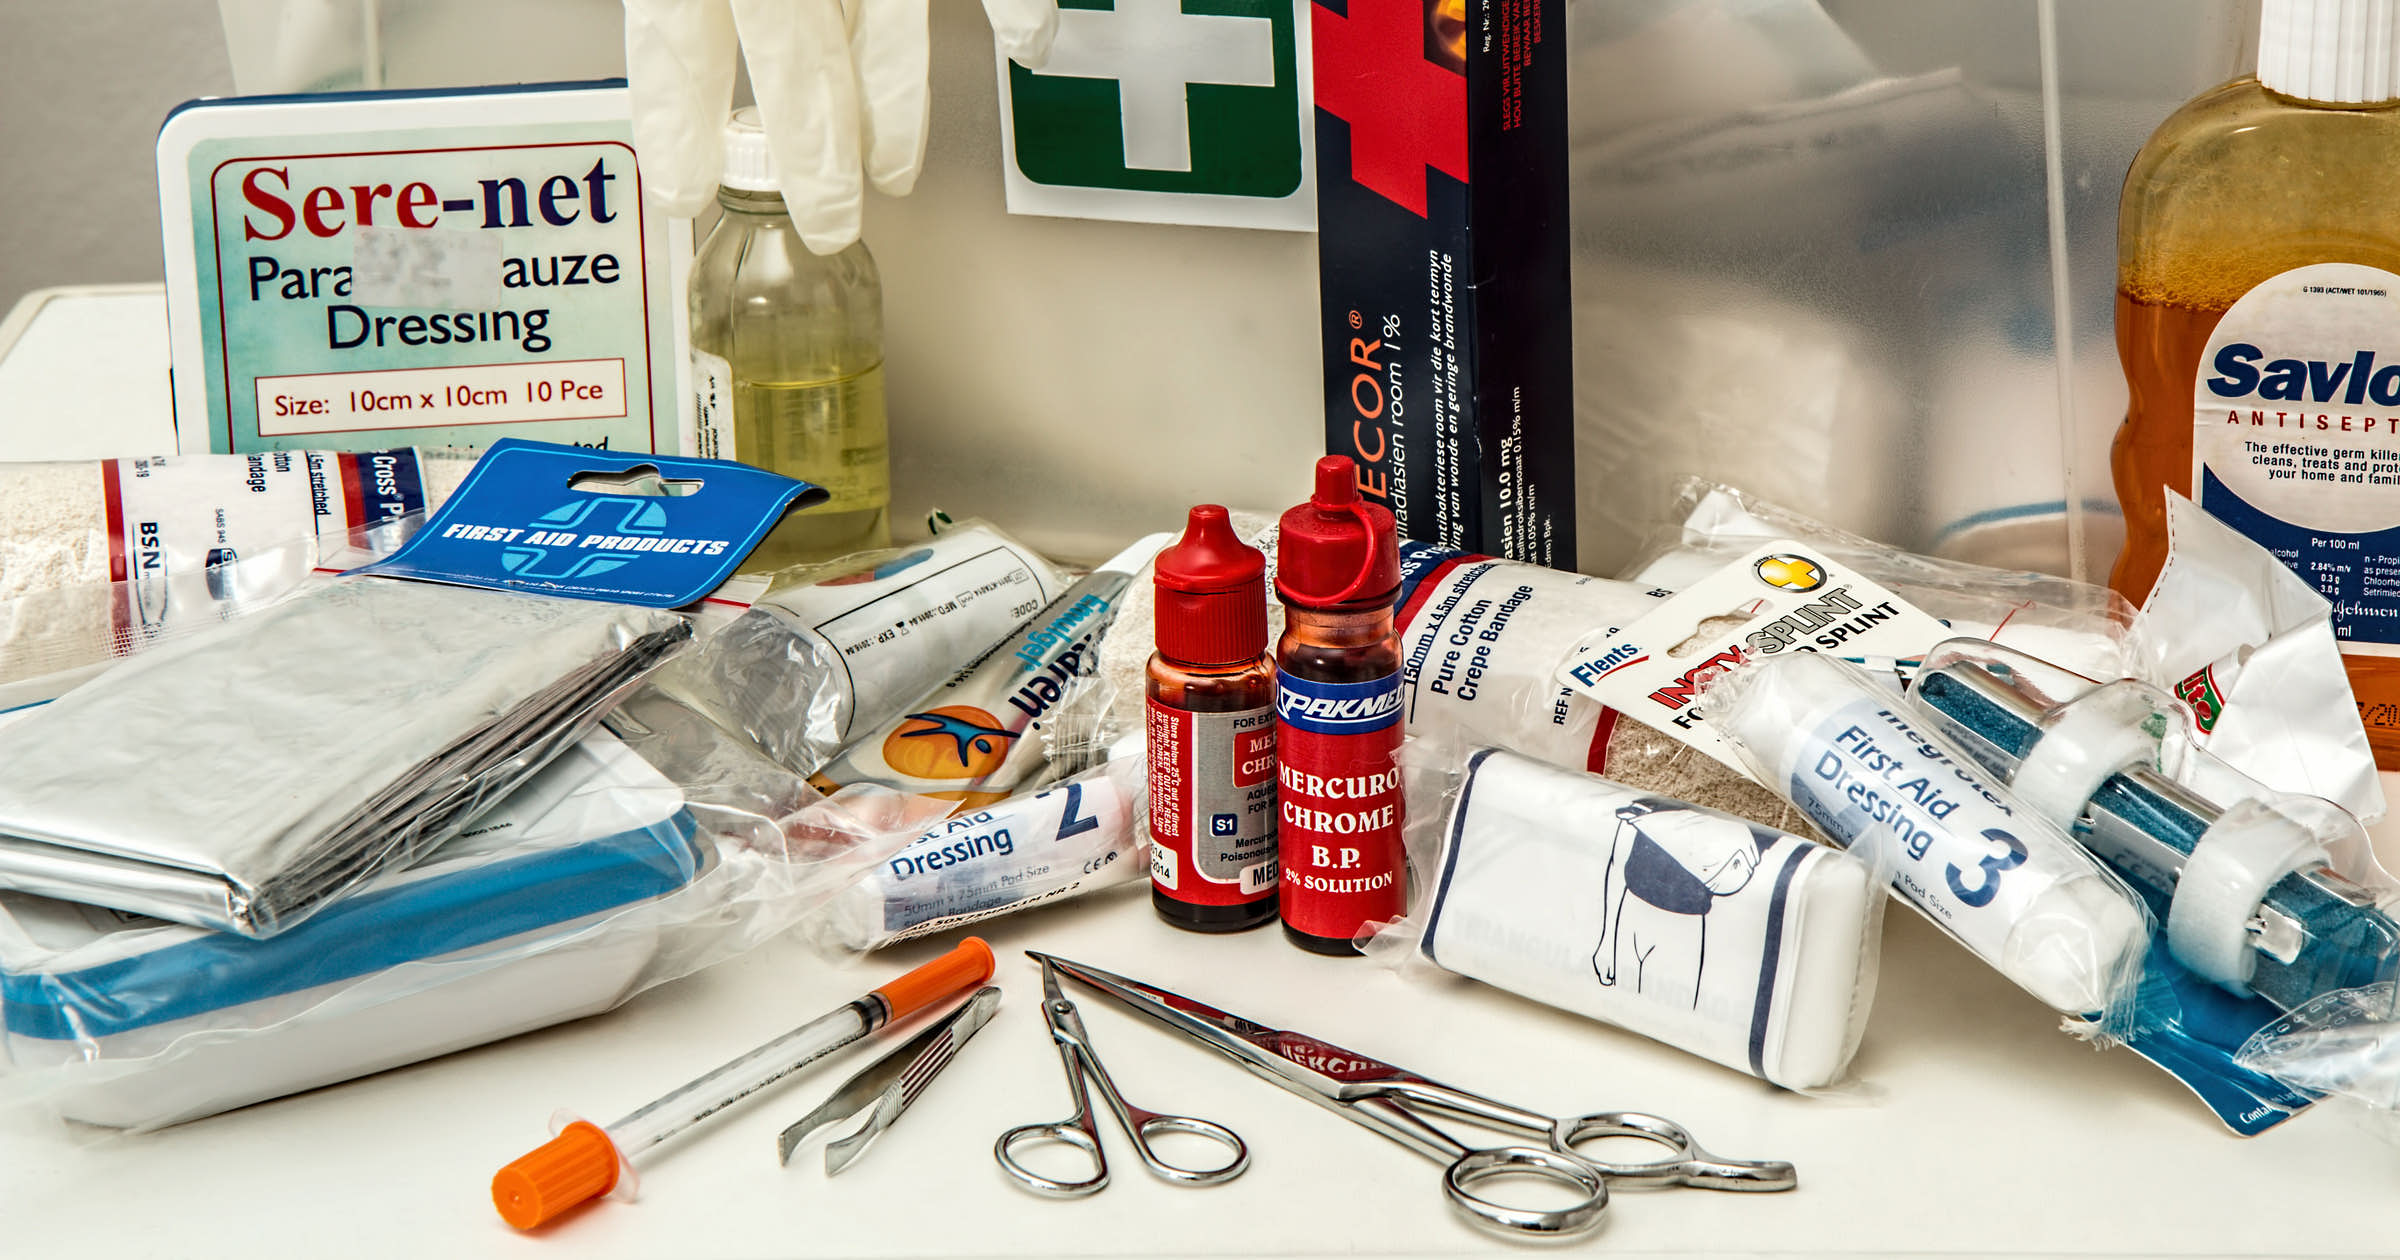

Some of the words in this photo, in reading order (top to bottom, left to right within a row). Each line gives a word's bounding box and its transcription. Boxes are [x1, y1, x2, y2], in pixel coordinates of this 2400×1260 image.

[1513, 100, 1521, 128] HOU
[241, 156, 618, 243] Sere-net
[249, 255, 352, 301] Para
[502, 251, 621, 289] auze
[1429, 250, 1441, 305] termyn
[1443, 254, 1455, 350] brandwonde
[327, 304, 553, 353] Dressing
[1430, 309, 1441, 342] kort
[1431, 347, 1442, 371] die
[1432, 373, 1443, 394] vir
[1445, 354, 1460, 412] geringe
[2207, 343, 2400, 406] Savlo
[275, 394, 330, 417] Size:
[349, 388, 412, 413] 10cm
[421, 393, 435, 408] x
[444, 385, 508, 408] 10cm
[526, 380, 553, 403] 10
[560, 379, 604, 402] Pce
[1389, 363, 1404, 427] room
[1447, 415, 1458, 434] en
[1513, 415, 1523, 452] 0.15%
[2227, 410, 2400, 434] ANTISEPT
[273, 451, 292, 473] otton
[1447, 438, 1460, 488] wonde
[1500, 437, 1513, 467] mg
[2245, 441, 2268, 452] The
[2272, 443, 2328, 456] effective
[2333, 448, 2365, 460] germ
[2252, 454, 2297, 468] cleans,
[2302, 458, 2339, 470] treats
[2344, 460, 2367, 472] and
[246, 453, 268, 493] andage
[2269, 469, 2296, 480] your
[2301, 469, 2335, 482] home
[2340, 472, 2364, 483] and
[2368, 473, 2400, 486] famil
[312, 470, 332, 515] stretched
[1499, 472, 1512, 509] 10.0
[1450, 491, 1460, 518] van
[442, 523, 525, 542] FIRST
[523, 531, 578, 546] AID
[578, 534, 730, 556] PRODUCTS
[1451, 523, 1464, 550] ling
[1500, 515, 1514, 559] asien
[1527, 512, 1537, 549] 0.05%
[2311, 537, 2327, 547] Per
[2329, 539, 2346, 549] 100
[2348, 540, 2360, 550] ml
[140, 522, 162, 569] BSN
[2310, 562, 2335, 572] 2.84%
[2378, 555, 2400, 566] Propi
[2320, 574, 2333, 582] 0.3
[2320, 585, 2333, 593] 3.0
[1010, 600, 1039, 618] CODE:
[1816, 601, 1899, 649] SPLINT
[2337, 625, 2351, 636] ml
[1430, 650, 1461, 695] Pure
[1450, 599, 1493, 646] Cotton
[1457, 644, 1491, 702] Crepe
[1479, 585, 1534, 642] Bandage
[1404, 633, 1433, 686] 150mm
[1569, 643, 1638, 688] Flents
[1233, 717, 1256, 729] FOR
[1554, 700, 1570, 725] REF
[1161, 714, 1171, 748] sunlight.
[1169, 716, 1180, 740] Store
[1163, 751, 1171, 773] KEEP
[1171, 741, 1180, 765] below
[1242, 752, 1276, 775] CHR
[1163, 775, 1171, 793] OUT
[1835, 724, 1904, 782] First
[1897, 776, 1961, 822] Aid
[1163, 794, 1171, 805] OF
[1171, 788, 1180, 801] out
[1171, 803, 1180, 812] of
[947, 810, 993, 834] Aid
[1036, 782, 1100, 842] 2
[1164, 806, 1172, 837] REACH
[1171, 813, 1181, 837] direct
[1216, 818, 1234, 831] S1
[1283, 800, 1394, 834] CHROME
[1814, 749, 1936, 863] Dressing
[1945, 827, 2029, 908] 3
[890, 828, 1015, 882] Dressing
[1312, 845, 1361, 869] B.P.
[1027, 864, 1051, 879] Size
[1304, 870, 1393, 893] SOLUTION
[1904, 874, 1926, 899] Pad
